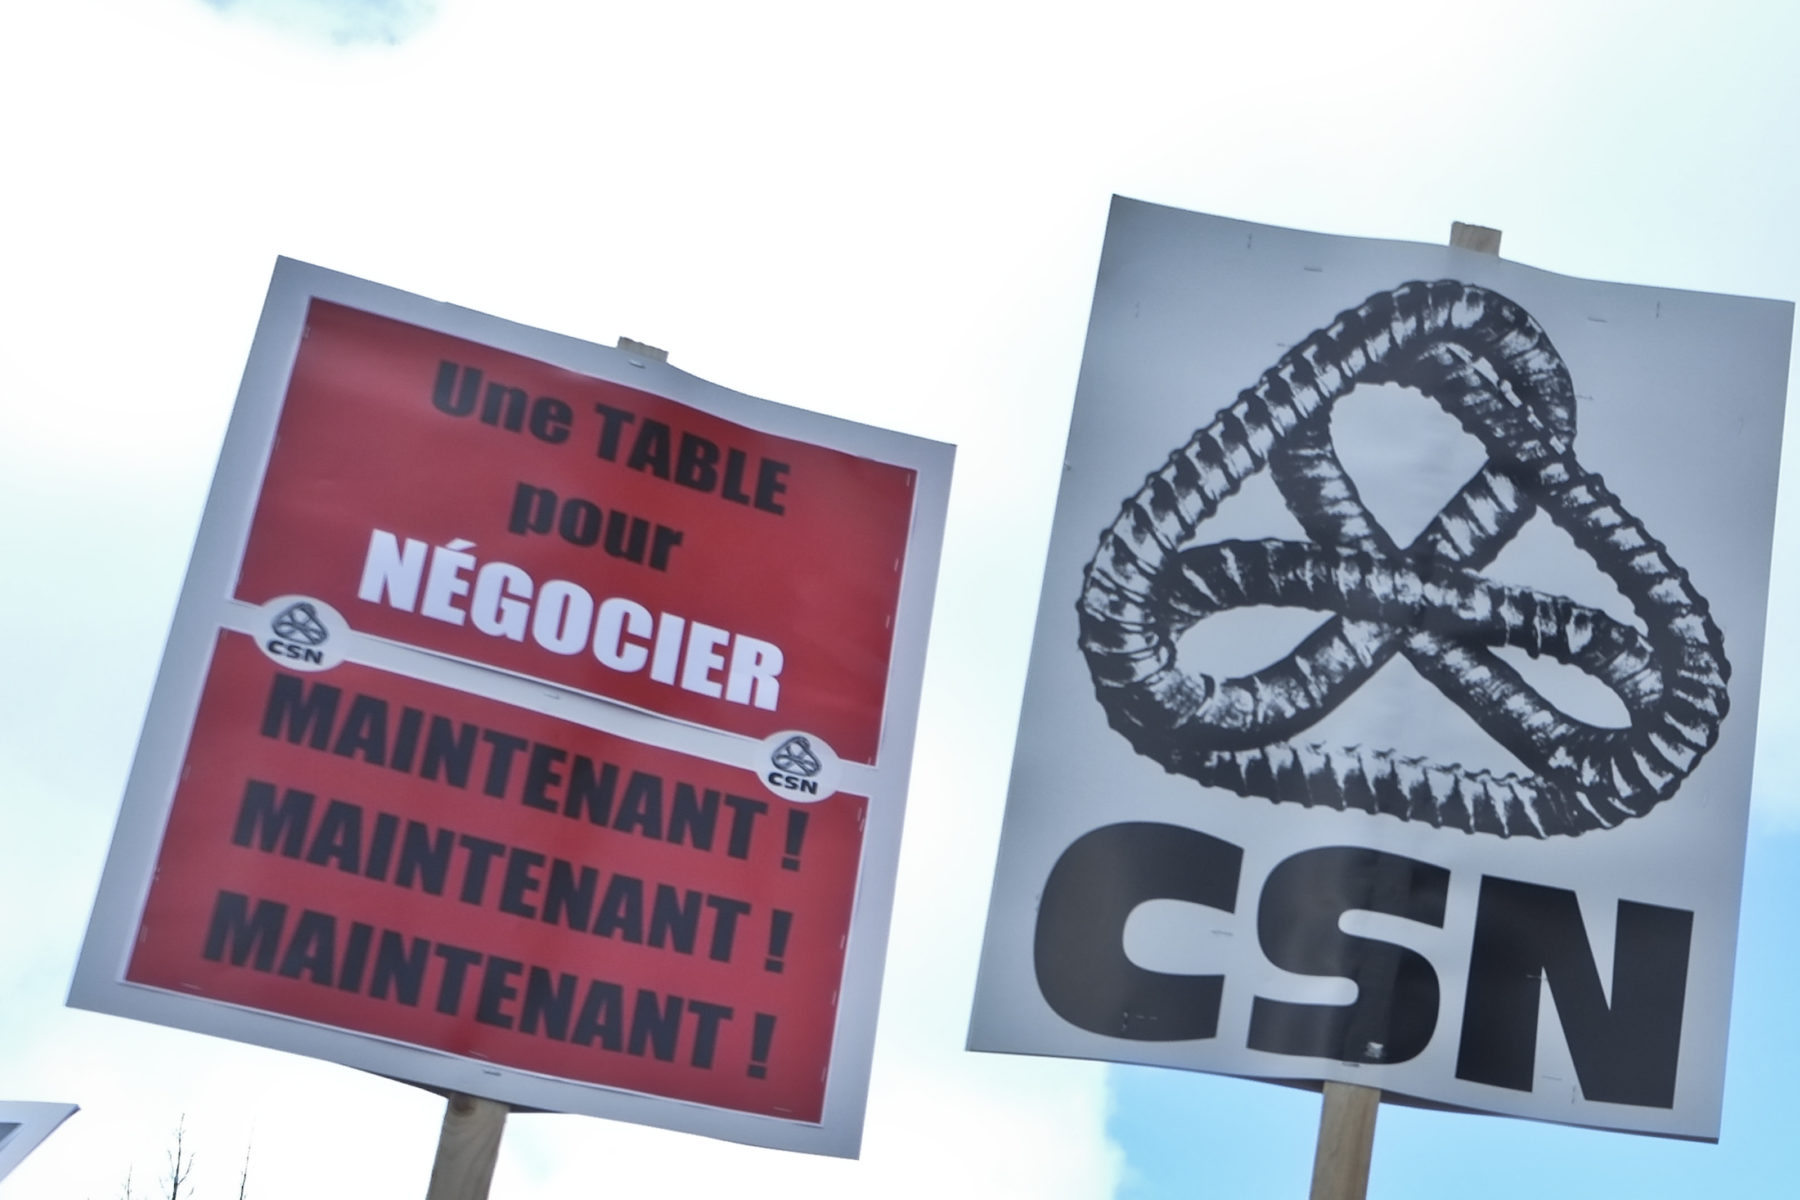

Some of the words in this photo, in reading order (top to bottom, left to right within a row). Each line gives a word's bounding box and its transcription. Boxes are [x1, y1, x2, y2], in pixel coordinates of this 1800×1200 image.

[431, 360, 573, 446] Une
[595, 402, 791, 517] TABLE
[507, 480, 684, 573] pour
[267, 640, 324, 665] CSN
[358, 528, 786, 713] NÉGOCIER
[258, 672, 768, 861] MAINTENANT
[768, 772, 819, 796] CSN
[230, 780, 752, 964] MAINTENANT
[202, 888, 735, 1071] MAINTENANT
[1033, 820, 1694, 1110] CSN
